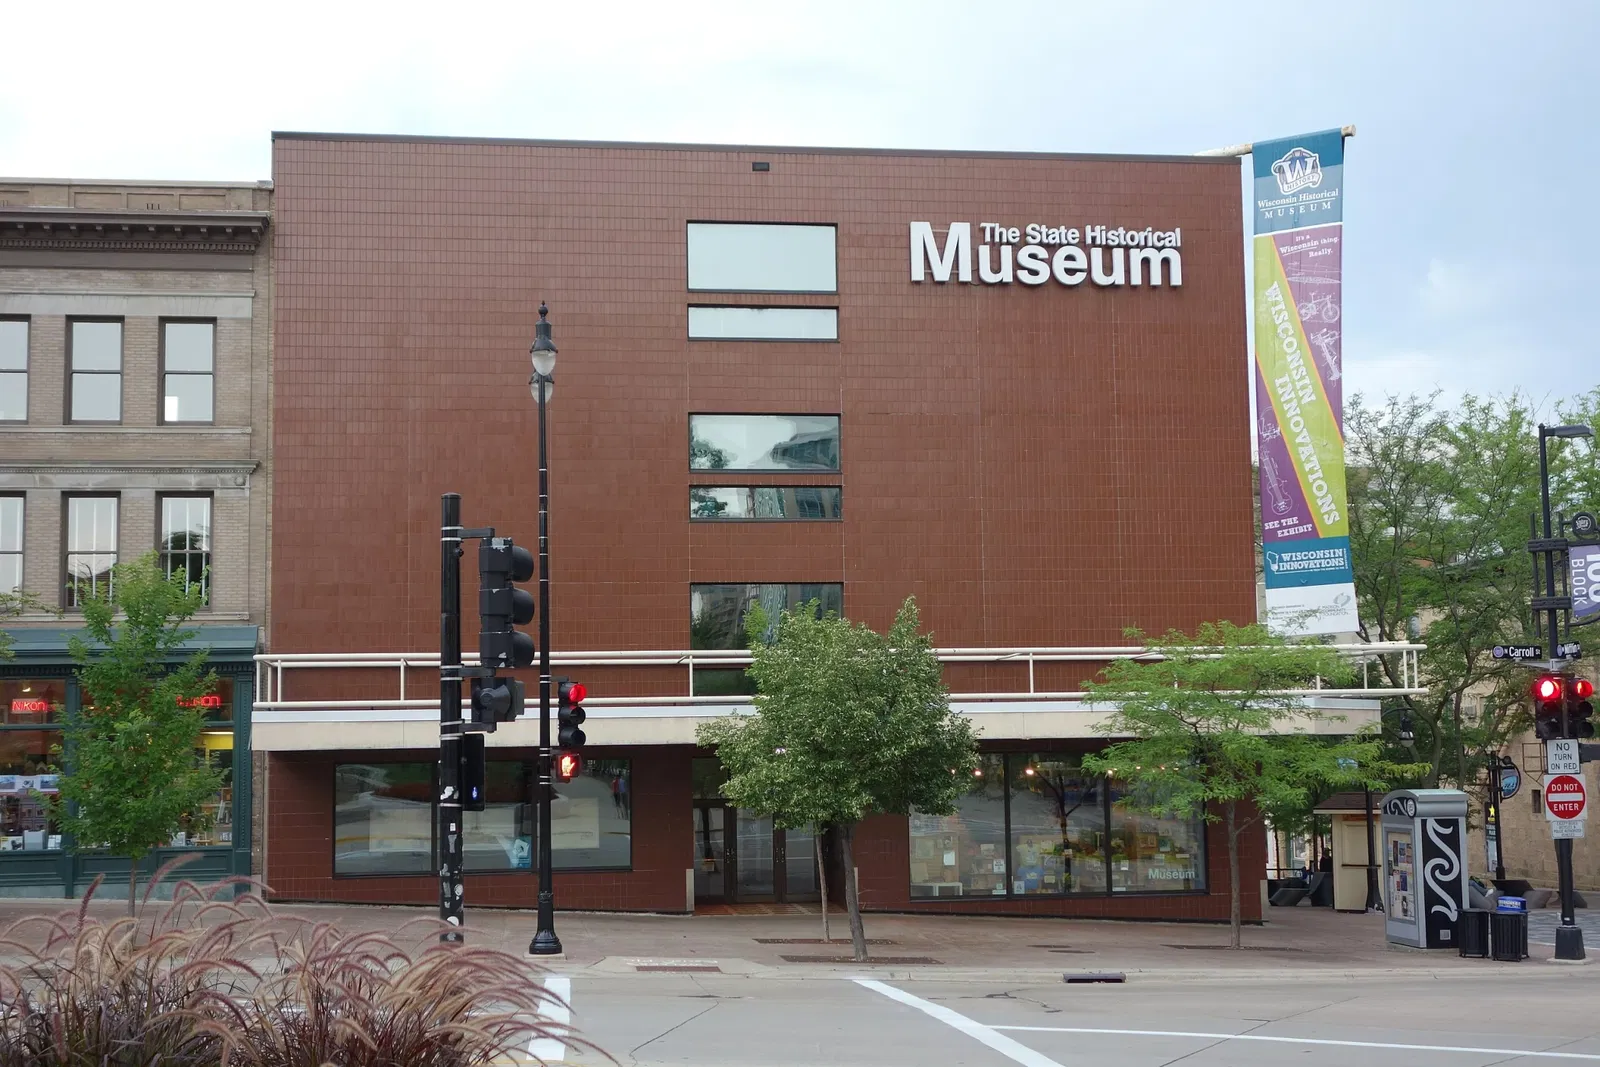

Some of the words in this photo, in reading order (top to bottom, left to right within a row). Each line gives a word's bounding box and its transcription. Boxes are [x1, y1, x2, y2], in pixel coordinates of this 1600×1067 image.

[1258, 196, 1297, 208] Wisconsin
[1299, 188, 1339, 201] Historical
[1264, 202, 1331, 219] MUSEUM
[980, 223, 1020, 244] The
[1025, 223, 1080, 245] State
[1085, 225, 1181, 248] Historical
[910, 221, 1183, 286] Museum
[1280, 240, 1319, 254] Wisconsin
[1309, 248, 1333, 258] Really.
[1265, 281, 1317, 405] WISCONSIN
[1274, 373, 1341, 525] INNOVATIONS
[1264, 520, 1280, 530] SEE
[1281, 516, 1299, 526] THE
[1277, 524, 1313, 537] EXHIBIT
[1281, 548, 1343, 561] WISCONSIN
[1279, 558, 1345, 571] INNOVATIONS
[1571, 558, 1588, 605] BLOCK
[1509, 646, 1534, 657] Carroll
[12, 701, 46, 711] Nikon
[1556, 743, 1570, 751] NO
[1564, 783, 1578, 791] NOT
[1553, 803, 1579, 811] ENTER
[1148, 868, 1195, 880] Museum
